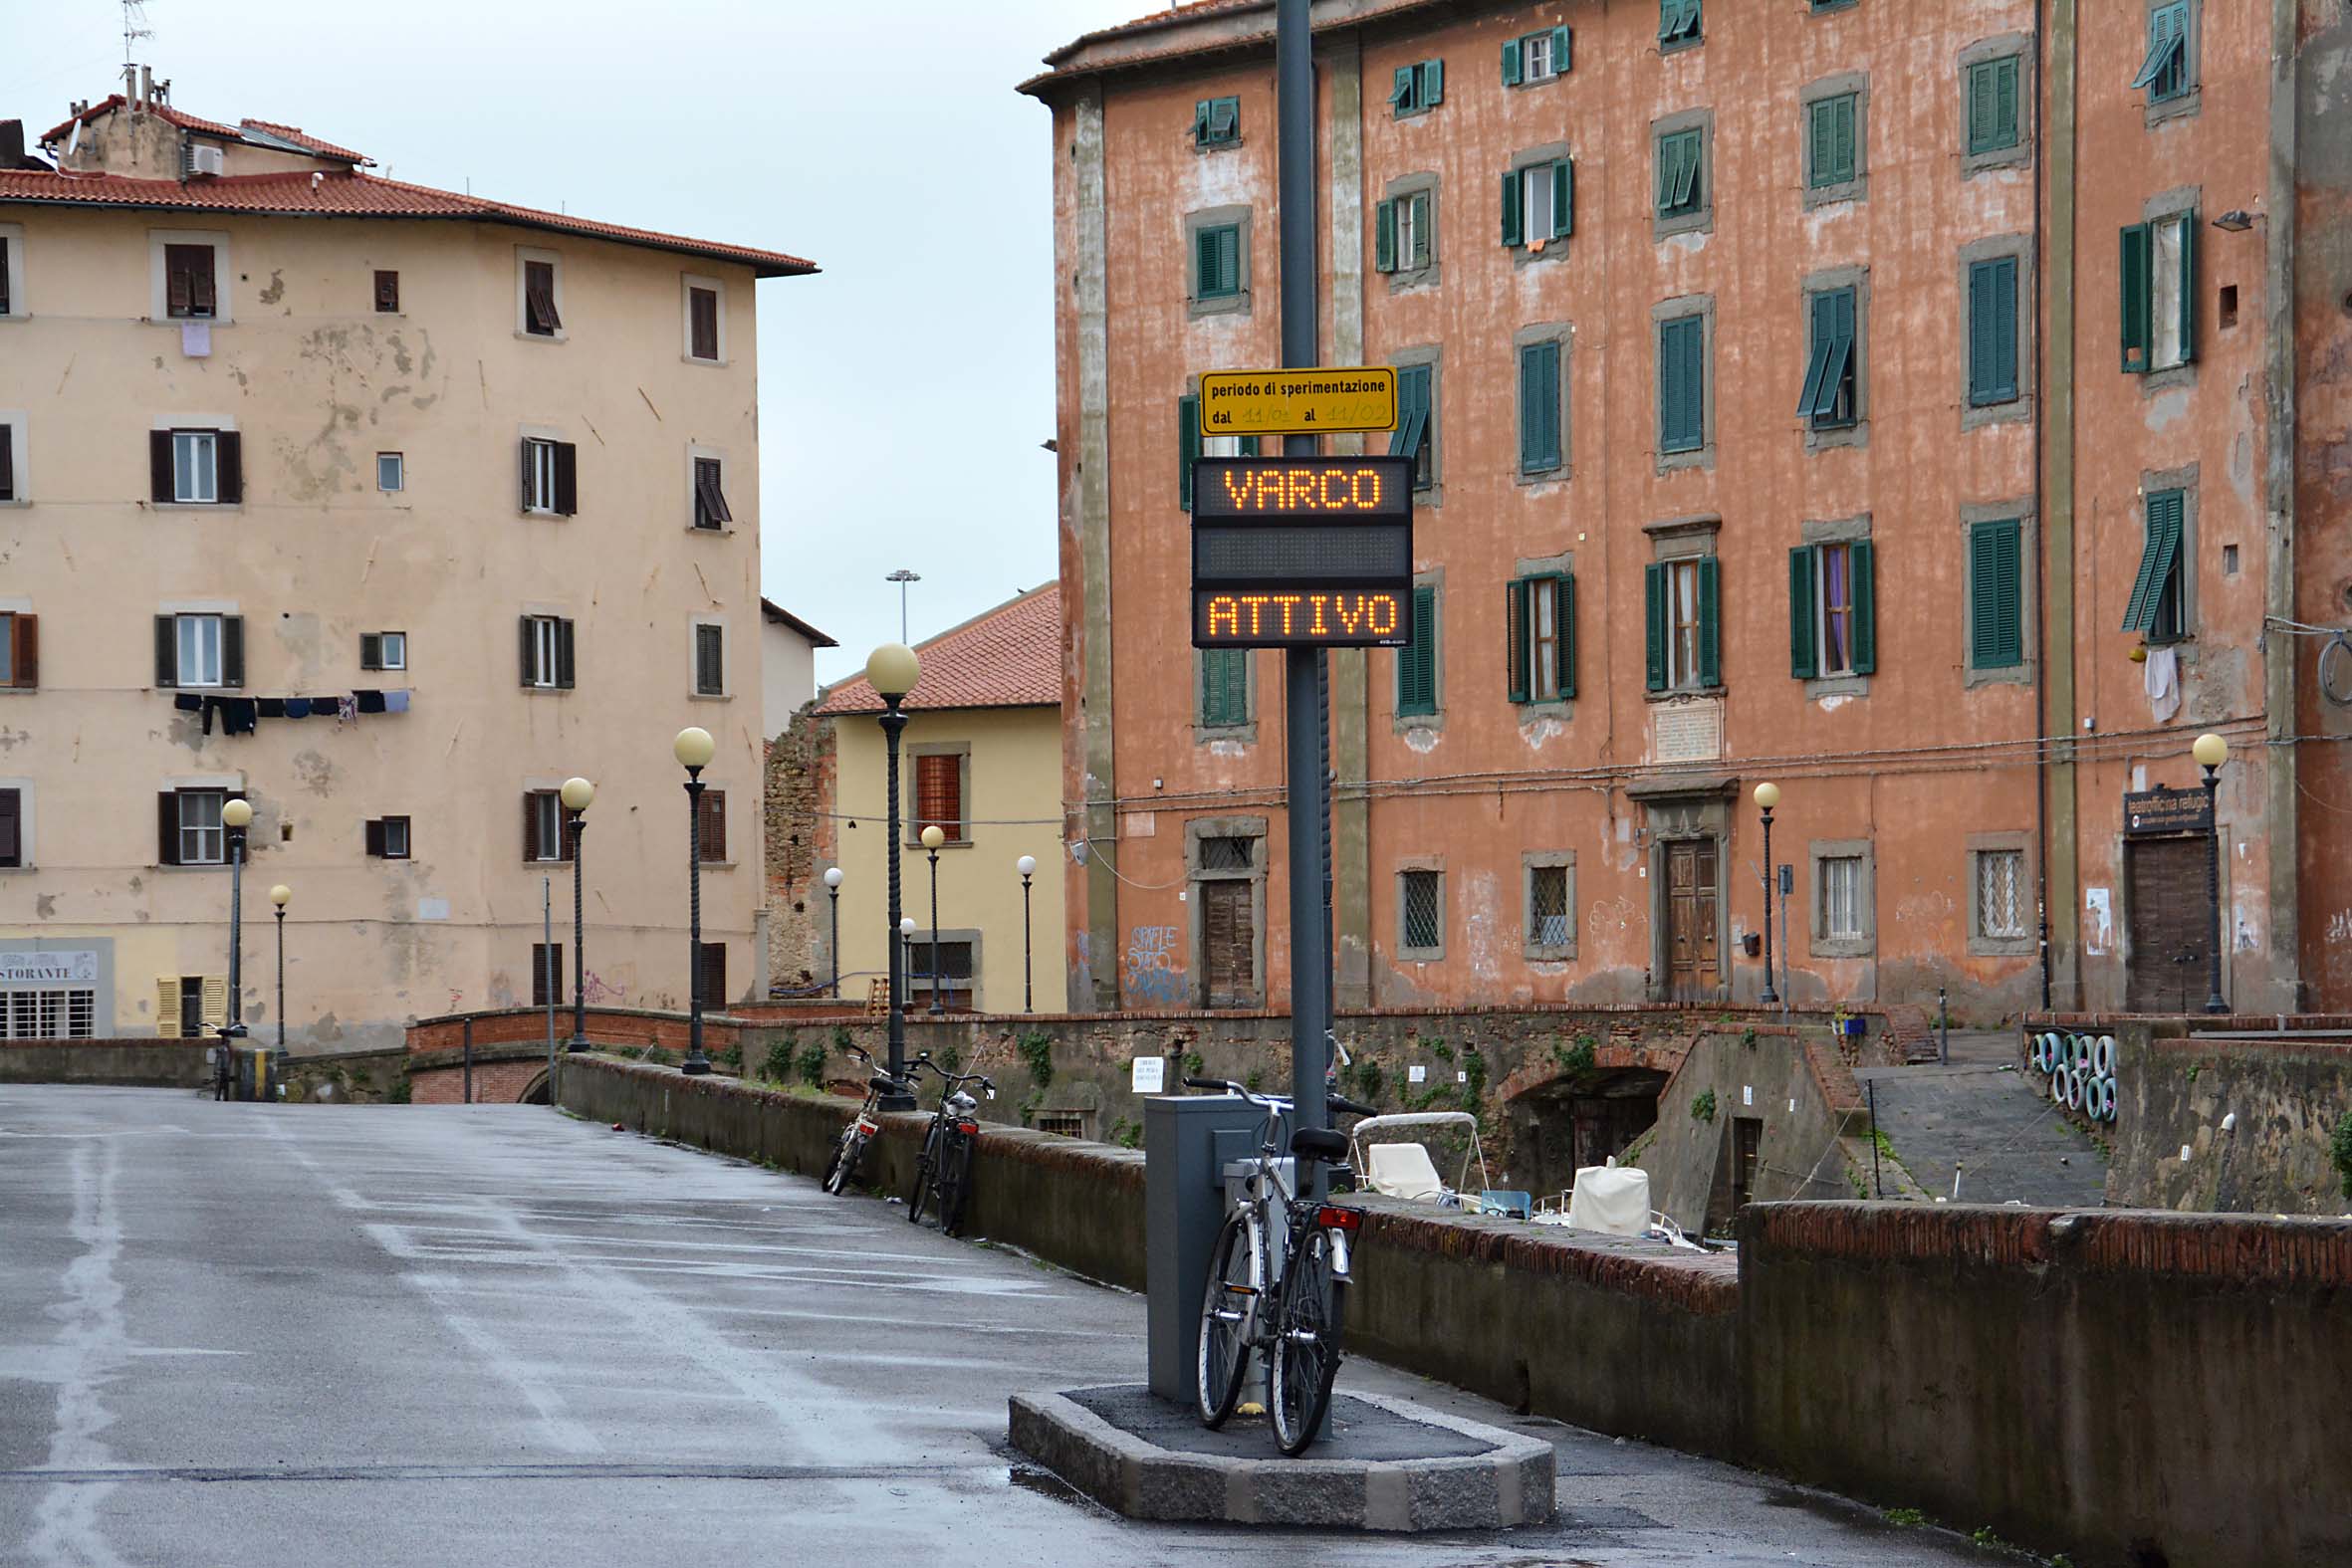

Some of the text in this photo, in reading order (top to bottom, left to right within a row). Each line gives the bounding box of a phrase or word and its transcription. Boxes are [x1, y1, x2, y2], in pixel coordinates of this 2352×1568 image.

[1212, 379, 1385, 399] periodo di sperimentazione
[1213, 410, 1232, 424] dal
[1304, 408, 1316, 421] al
[1225, 469, 1383, 510] VARCO
[1208, 594, 1397, 636] ATTIVO
